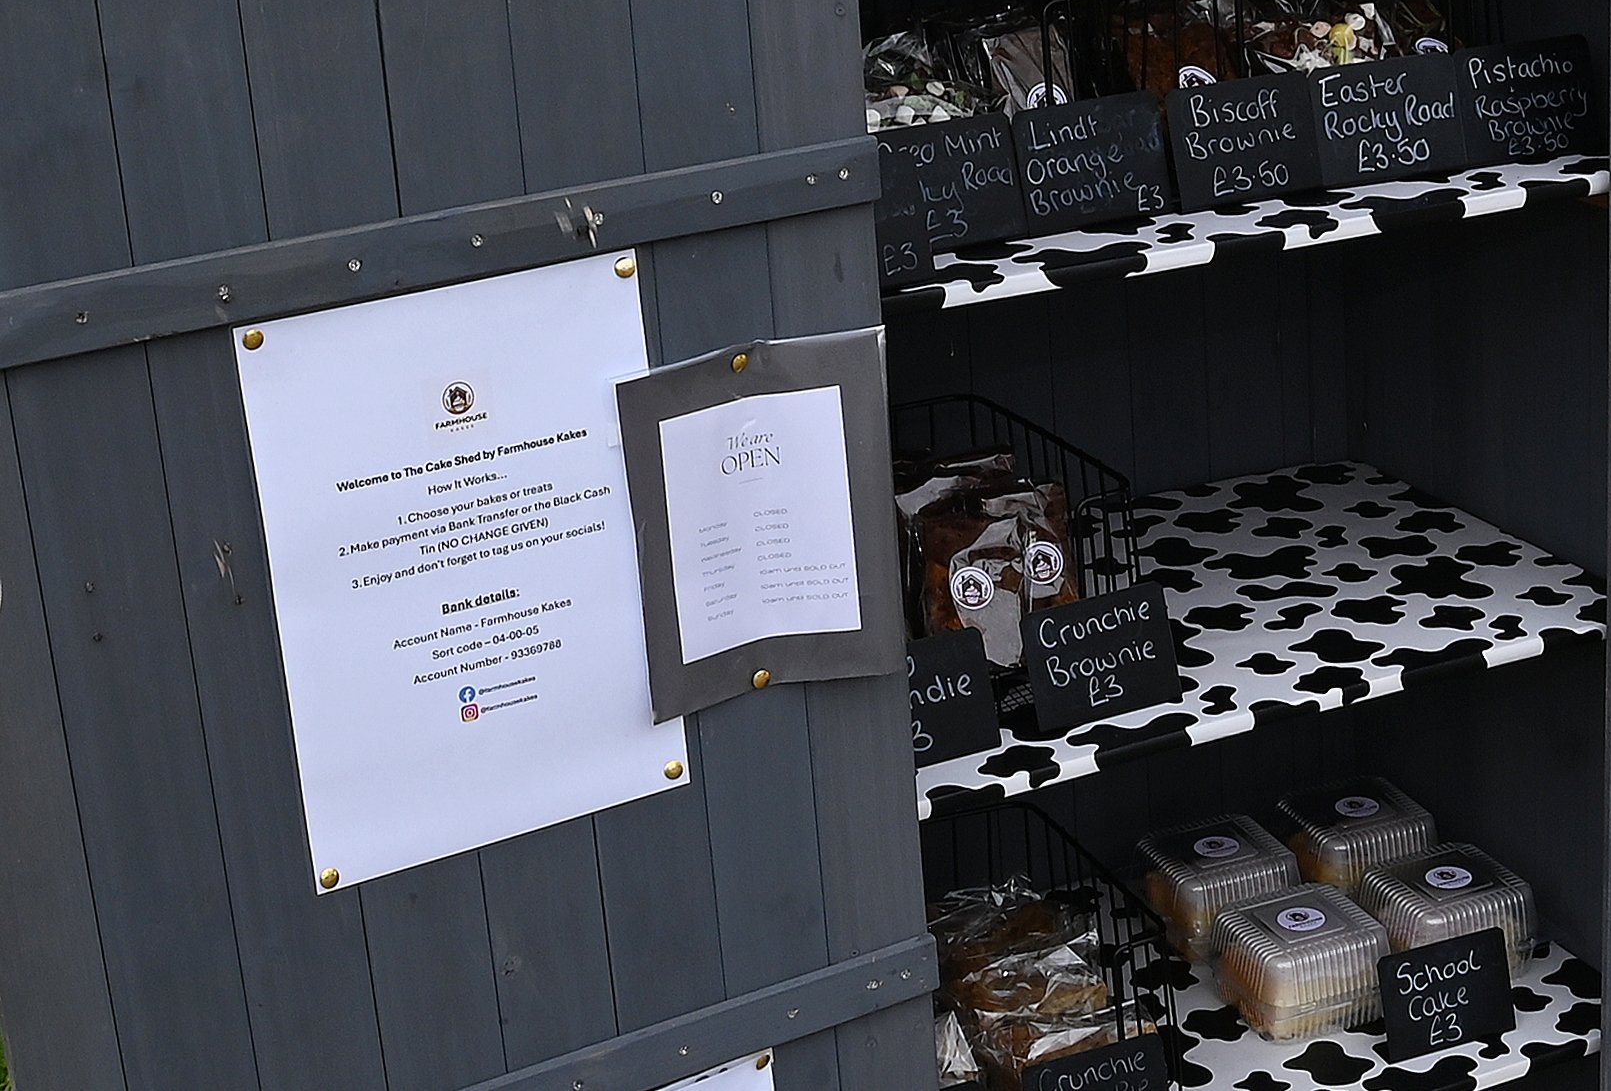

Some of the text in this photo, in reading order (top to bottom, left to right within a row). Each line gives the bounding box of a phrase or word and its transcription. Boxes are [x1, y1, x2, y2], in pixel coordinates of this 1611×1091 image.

[1468, 52, 1574, 89] Pistachio
[1318, 73, 1407, 107] Easter
[1475, 87, 1588, 119] Raspberry
[1190, 89, 1279, 127] Biscoff
[1324, 92, 1455, 142] Rocky Road
[944, 126, 1001, 157] Mint
[1029, 115, 1098, 150] Lindt
[1185, 123, 1296, 160] Brownie
[1488, 112, 1575, 142] Brownie
[1027, 144, 1124, 184] Orange
[1357, 138, 1430, 173] £3.50
[1029, 172, 1140, 216] Brownie
[1138, 184, 1165, 212] £3
[435, 412, 488, 429] FARMHOUSE
[728, 432, 773, 450] We are
[336, 429, 587, 492] Welcome to The Cake Shed by Farmhouse Kakes
[721, 446, 780, 475] OPEN
[427, 482, 452, 495] How
[454, 479, 462, 489] It
[451, 500, 475, 515] your
[477, 493, 508, 507] bakes
[510, 490, 521, 499] or
[522, 482, 553, 497] treats
[381, 528, 429, 549] payment
[430, 524, 446, 536] via
[448, 517, 475, 531] Bank
[477, 508, 519, 525] Transfer
[521, 504, 532, 514] or
[534, 500, 551, 511] the
[553, 492, 582, 507] Black
[583, 486, 611, 499] Cash
[753, 508, 788, 518] CLOSED
[754, 523, 789, 532] CLOSED
[394, 565, 415, 579] and
[417, 559, 444, 574] don't
[446, 552, 477, 566] forget
[479, 548, 490, 558] to
[492, 543, 509, 556] tag
[510, 541, 524, 552] us
[525, 538, 539, 548] on
[540, 531, 563, 546] your
[565, 520, 606, 538] socials!
[419, 517, 549, 555] Tin (NO CHANGE GIVEN)
[756, 537, 791, 547] CLOSED
[757, 552, 792, 562] CLOSED
[441, 588, 520, 615] Bank details:
[393, 631, 438, 650] Account
[440, 623, 472, 638] Name
[480, 606, 539, 628] Farmhouse
[541, 599, 572, 613] Kakes
[1039, 600, 1150, 649] Crunchie
[432, 647, 455, 660] Sort
[456, 641, 483, 654] code
[492, 624, 540, 644] 04-00-05
[413, 666, 458, 685] Account
[459, 655, 502, 673] Number
[1046, 638, 1156, 688] Brownie
[909, 674, 972, 710] ndie
[1088, 674, 1124, 708] £3
[911, 719, 934, 752] 3
[1397, 949, 1481, 995] School
[1430, 1013, 1463, 1046] £3
[1039, 1051, 1146, 1091] Crunchie
